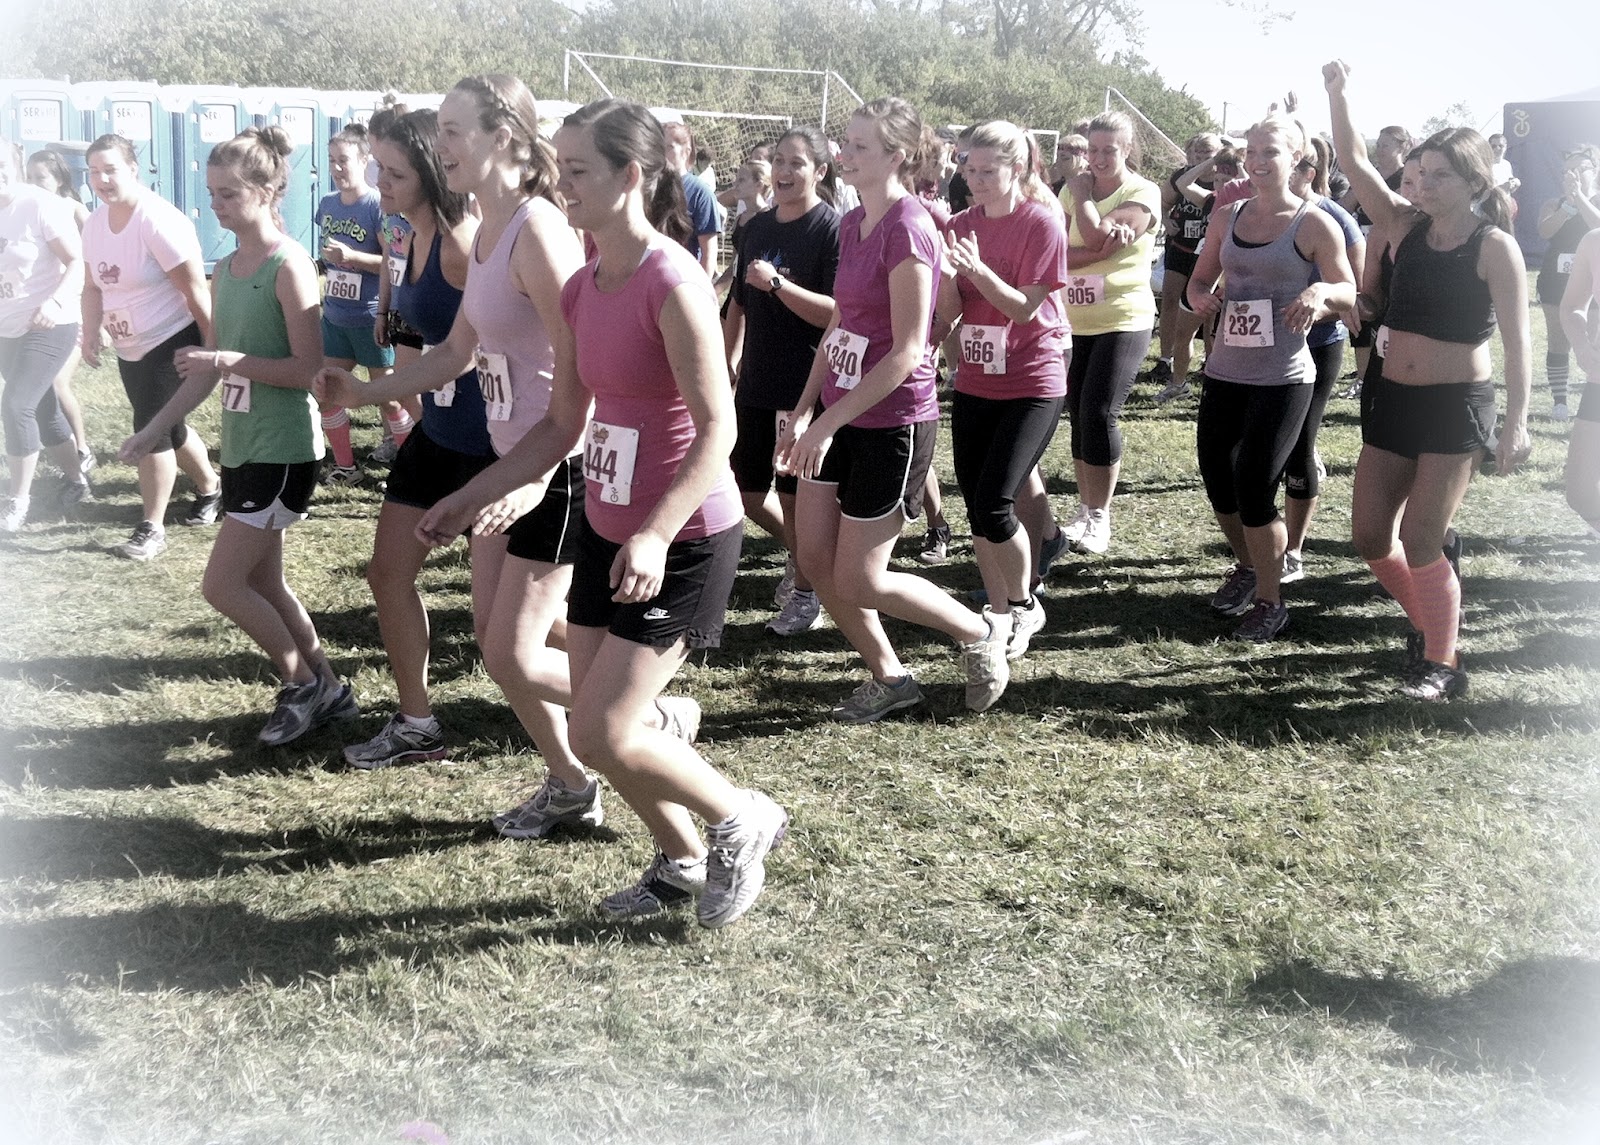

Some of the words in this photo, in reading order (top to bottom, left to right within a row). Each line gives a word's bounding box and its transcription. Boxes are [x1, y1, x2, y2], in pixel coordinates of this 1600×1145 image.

[321, 214, 367, 243] Besties
[325, 280, 357, 299] 1660
[1067, 287, 1096, 305] 905
[1228, 314, 1262, 336] 232
[825, 343, 858, 377] 1340
[964, 340, 994, 363] 566
[478, 370, 505, 404] 201
